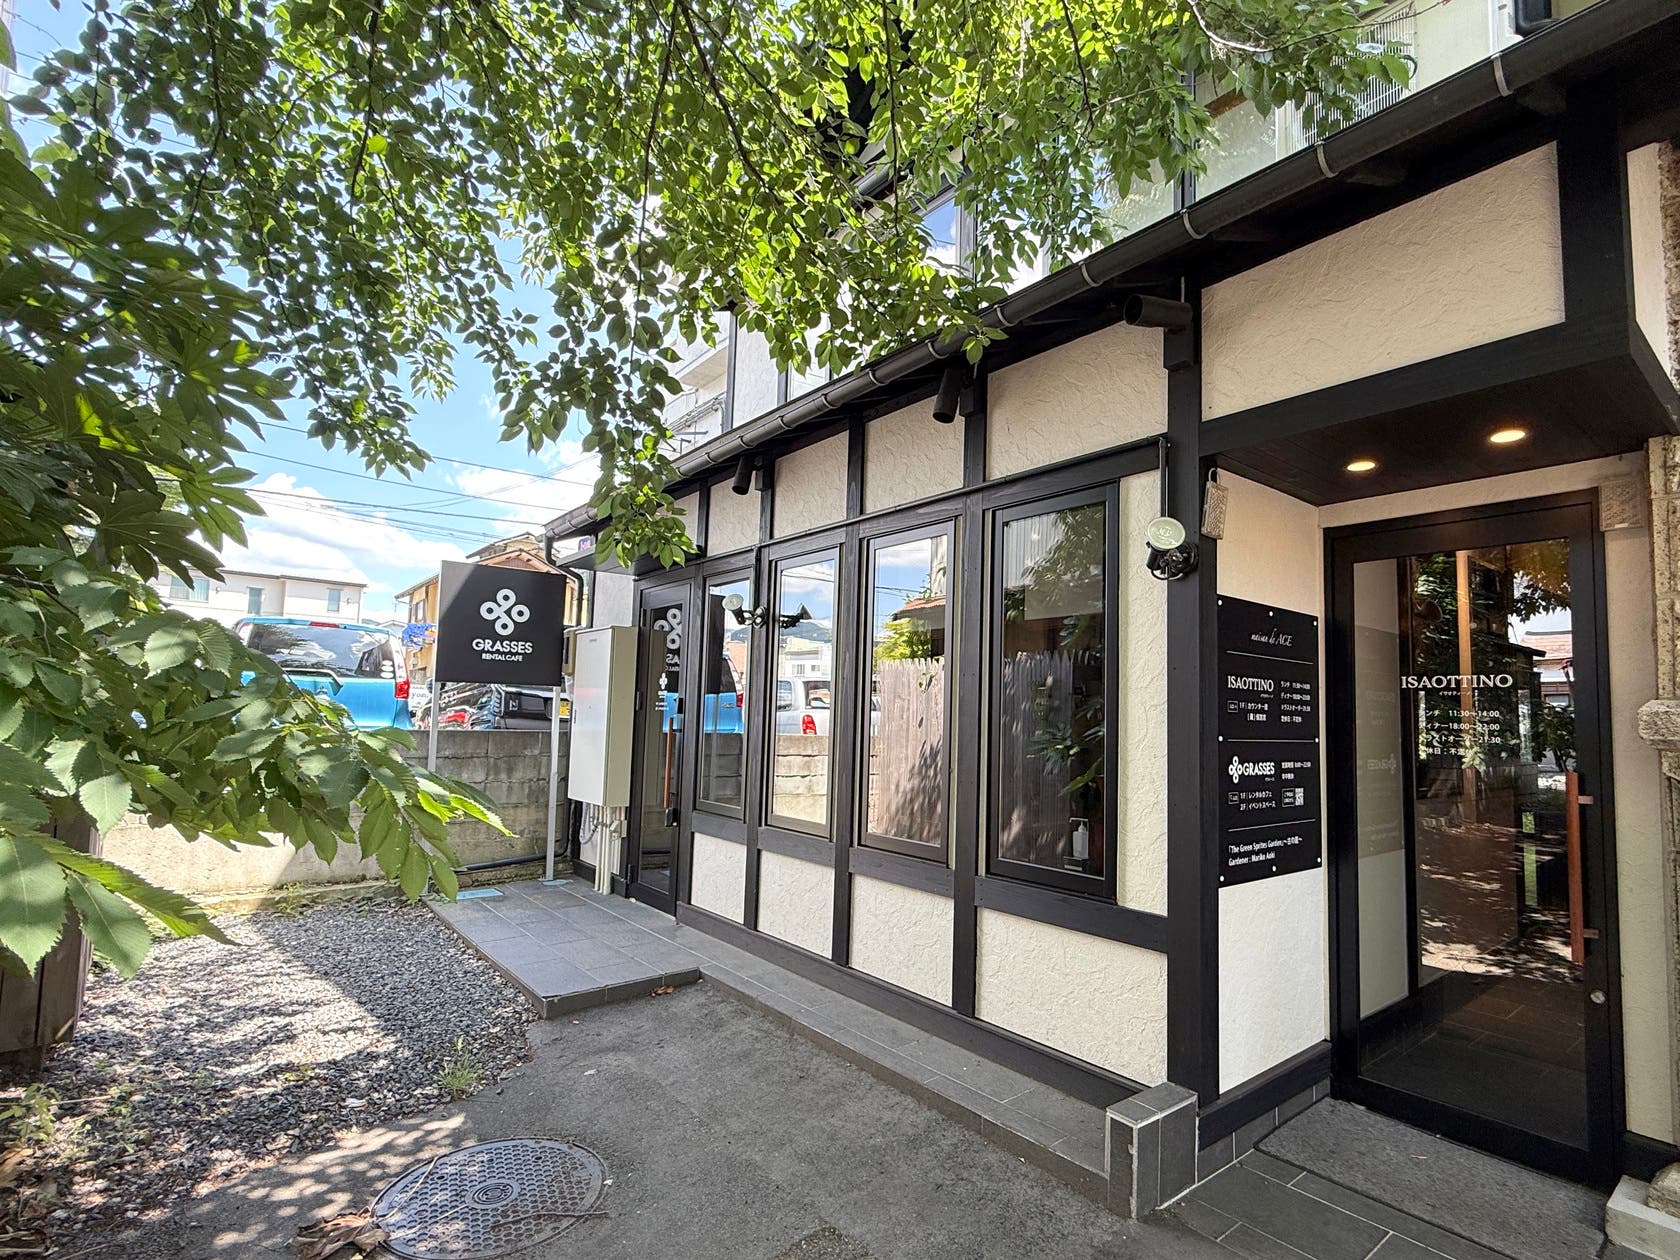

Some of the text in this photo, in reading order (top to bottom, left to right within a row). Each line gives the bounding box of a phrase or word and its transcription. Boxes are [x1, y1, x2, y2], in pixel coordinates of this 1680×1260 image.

[472, 638, 533, 654] GRASSES
[1227, 675, 1274, 692] ISAOTTINO
[1401, 674, 1513, 689] ISAOTTINO
[1242, 762, 1275, 776] GRASSES
